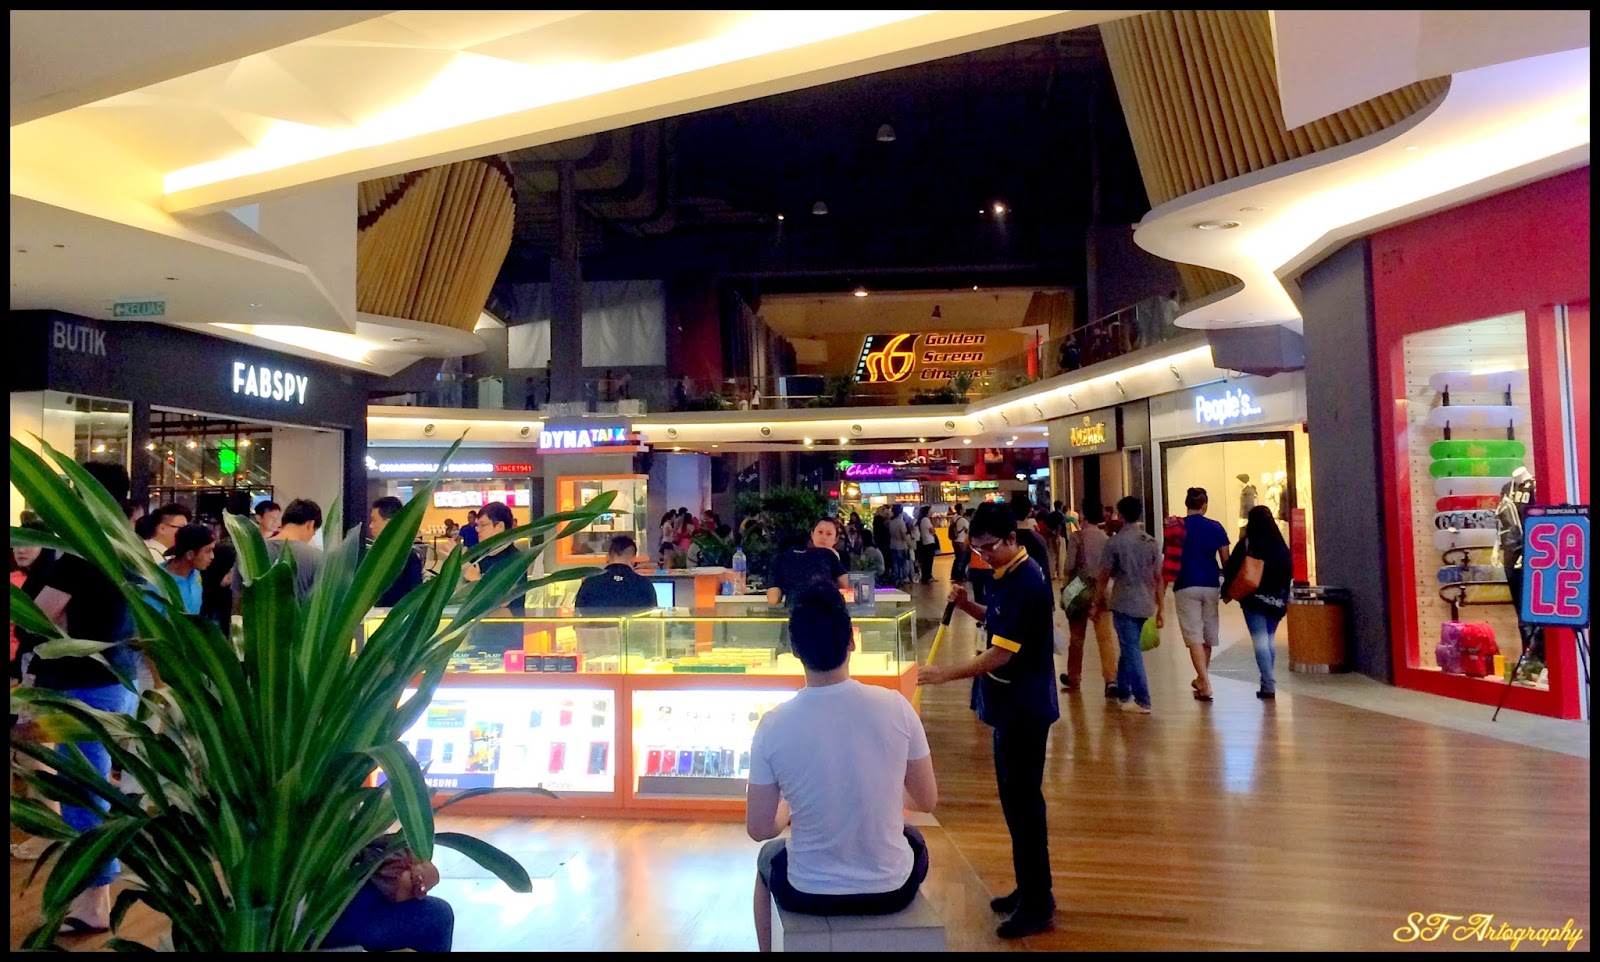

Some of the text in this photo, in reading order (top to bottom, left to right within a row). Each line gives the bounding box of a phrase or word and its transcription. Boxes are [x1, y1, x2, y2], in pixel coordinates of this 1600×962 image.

[124, 302, 165, 316] KELUAR
[53, 320, 107, 356] BUTIK
[924, 332, 986, 346] Golden
[922, 351, 984, 363] Screen
[233, 362, 309, 404] FABSPY
[846, 465, 894, 477] Chatime
